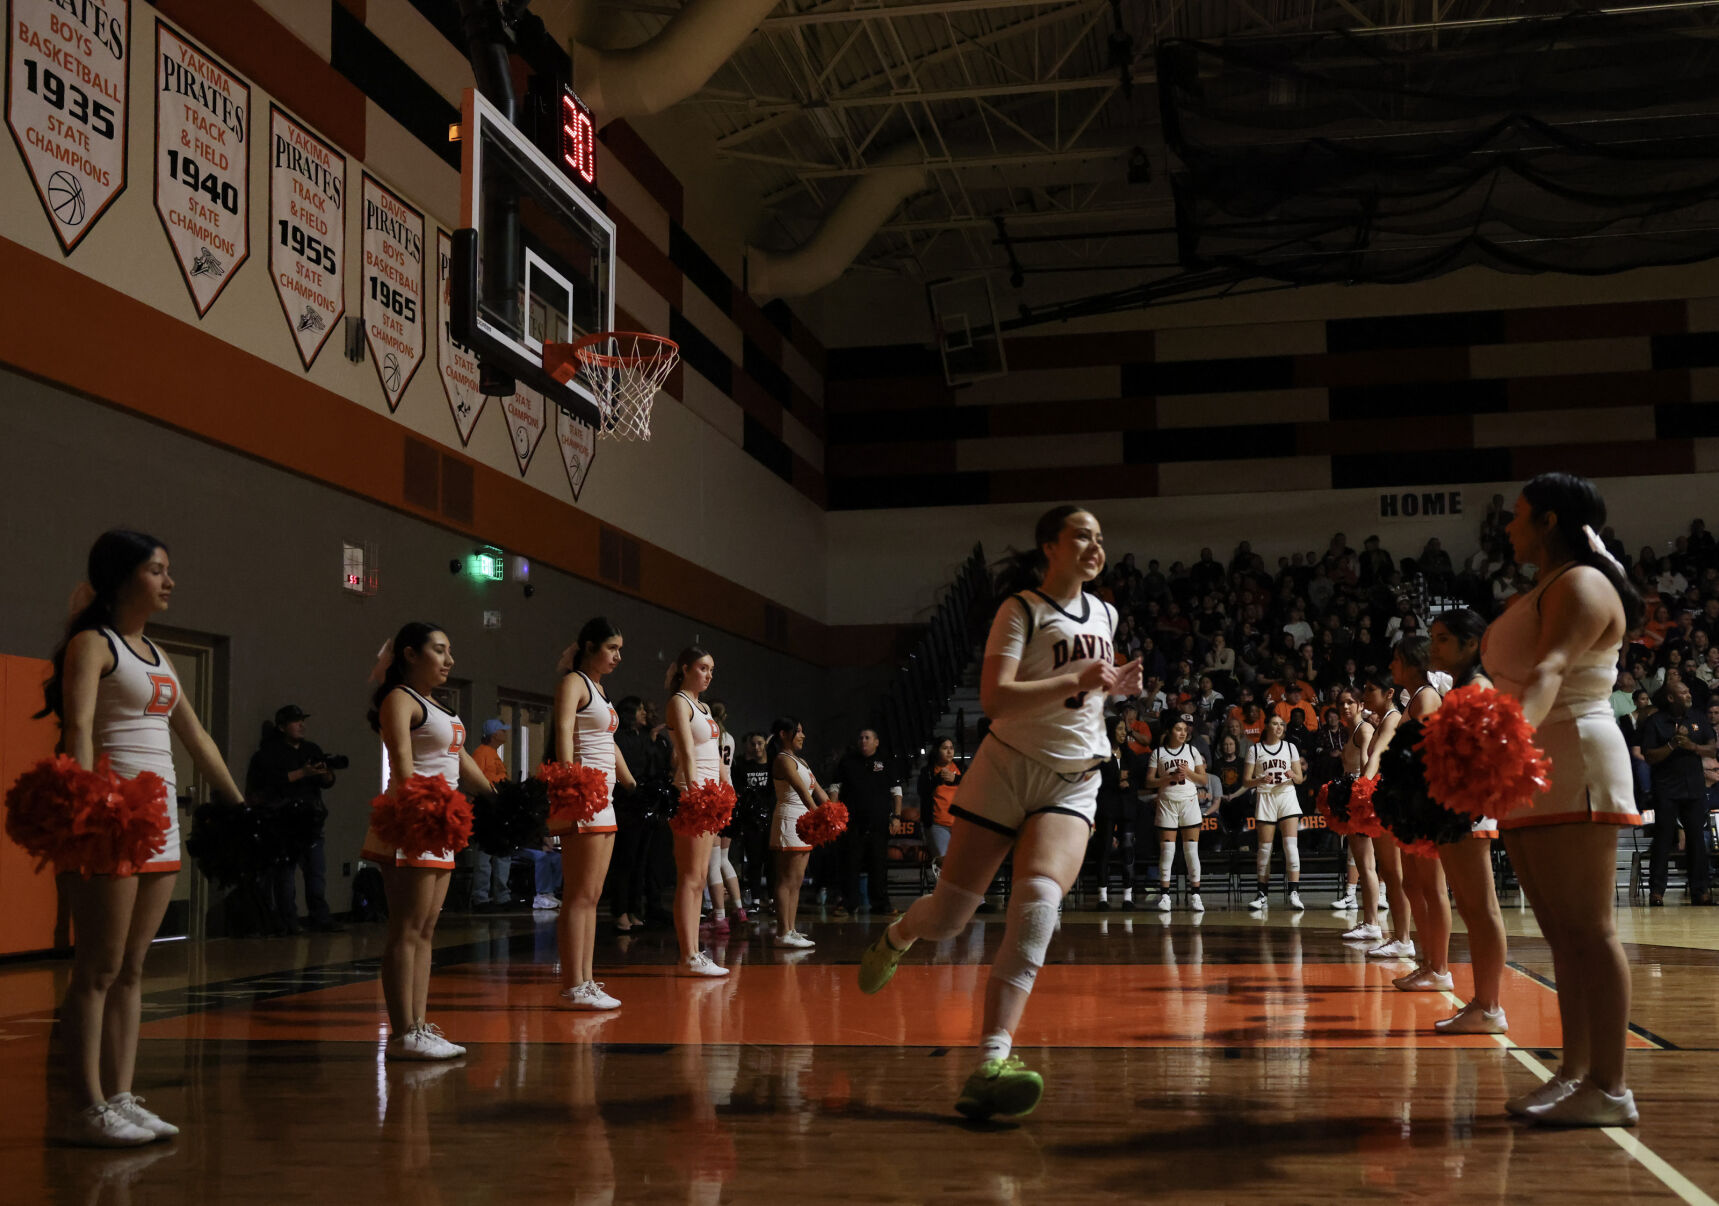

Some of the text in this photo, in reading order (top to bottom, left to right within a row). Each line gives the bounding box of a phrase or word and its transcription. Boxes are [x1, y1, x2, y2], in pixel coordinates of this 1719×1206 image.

[50, 13, 93, 57] BOYS
[19, 21, 121, 104] BASKETBALL
[178, 45, 231, 97] YAKIMA
[24, 58, 115, 140] 1935
[162, 53, 244, 143] PIRATES
[47, 114, 90, 152] STATE
[183, 103, 227, 147] TRACK
[563, 95, 593, 183] 30
[26, 126, 110, 188] CHAMPIONS
[181, 129, 229, 172] & FIELD
[288, 125, 331, 169] YAKIMA
[167, 149, 238, 216] 1940
[275, 133, 342, 210] PIRATES
[188, 196, 220, 228] STATE
[290, 200, 328, 235] & FIELD
[292, 178, 326, 214] TRACK
[381, 194, 407, 224] DAVIS
[169, 209, 235, 258] CHAMPIONS
[278, 219, 336, 275] 1955
[366, 199, 421, 264] PIRATES
[295, 260, 322, 287] STATE
[366, 250, 419, 297] BASKETBALL
[382, 240, 405, 267] BOYS
[280, 272, 336, 313] CHAMPIONS
[369, 276, 416, 324] 1965
[371, 324, 415, 360] CHAMPIONS
[382, 313, 404, 336] STATE
[446, 365, 479, 393] CHAMPION
[454, 354, 474, 374] STATE
[1380, 491, 1462, 517] HOME
[1052, 633, 1112, 670] DAVIS
[144, 671, 178, 717] D
[1262, 758, 1287, 771] DAVIS
[1200, 817, 1218, 831] HS
